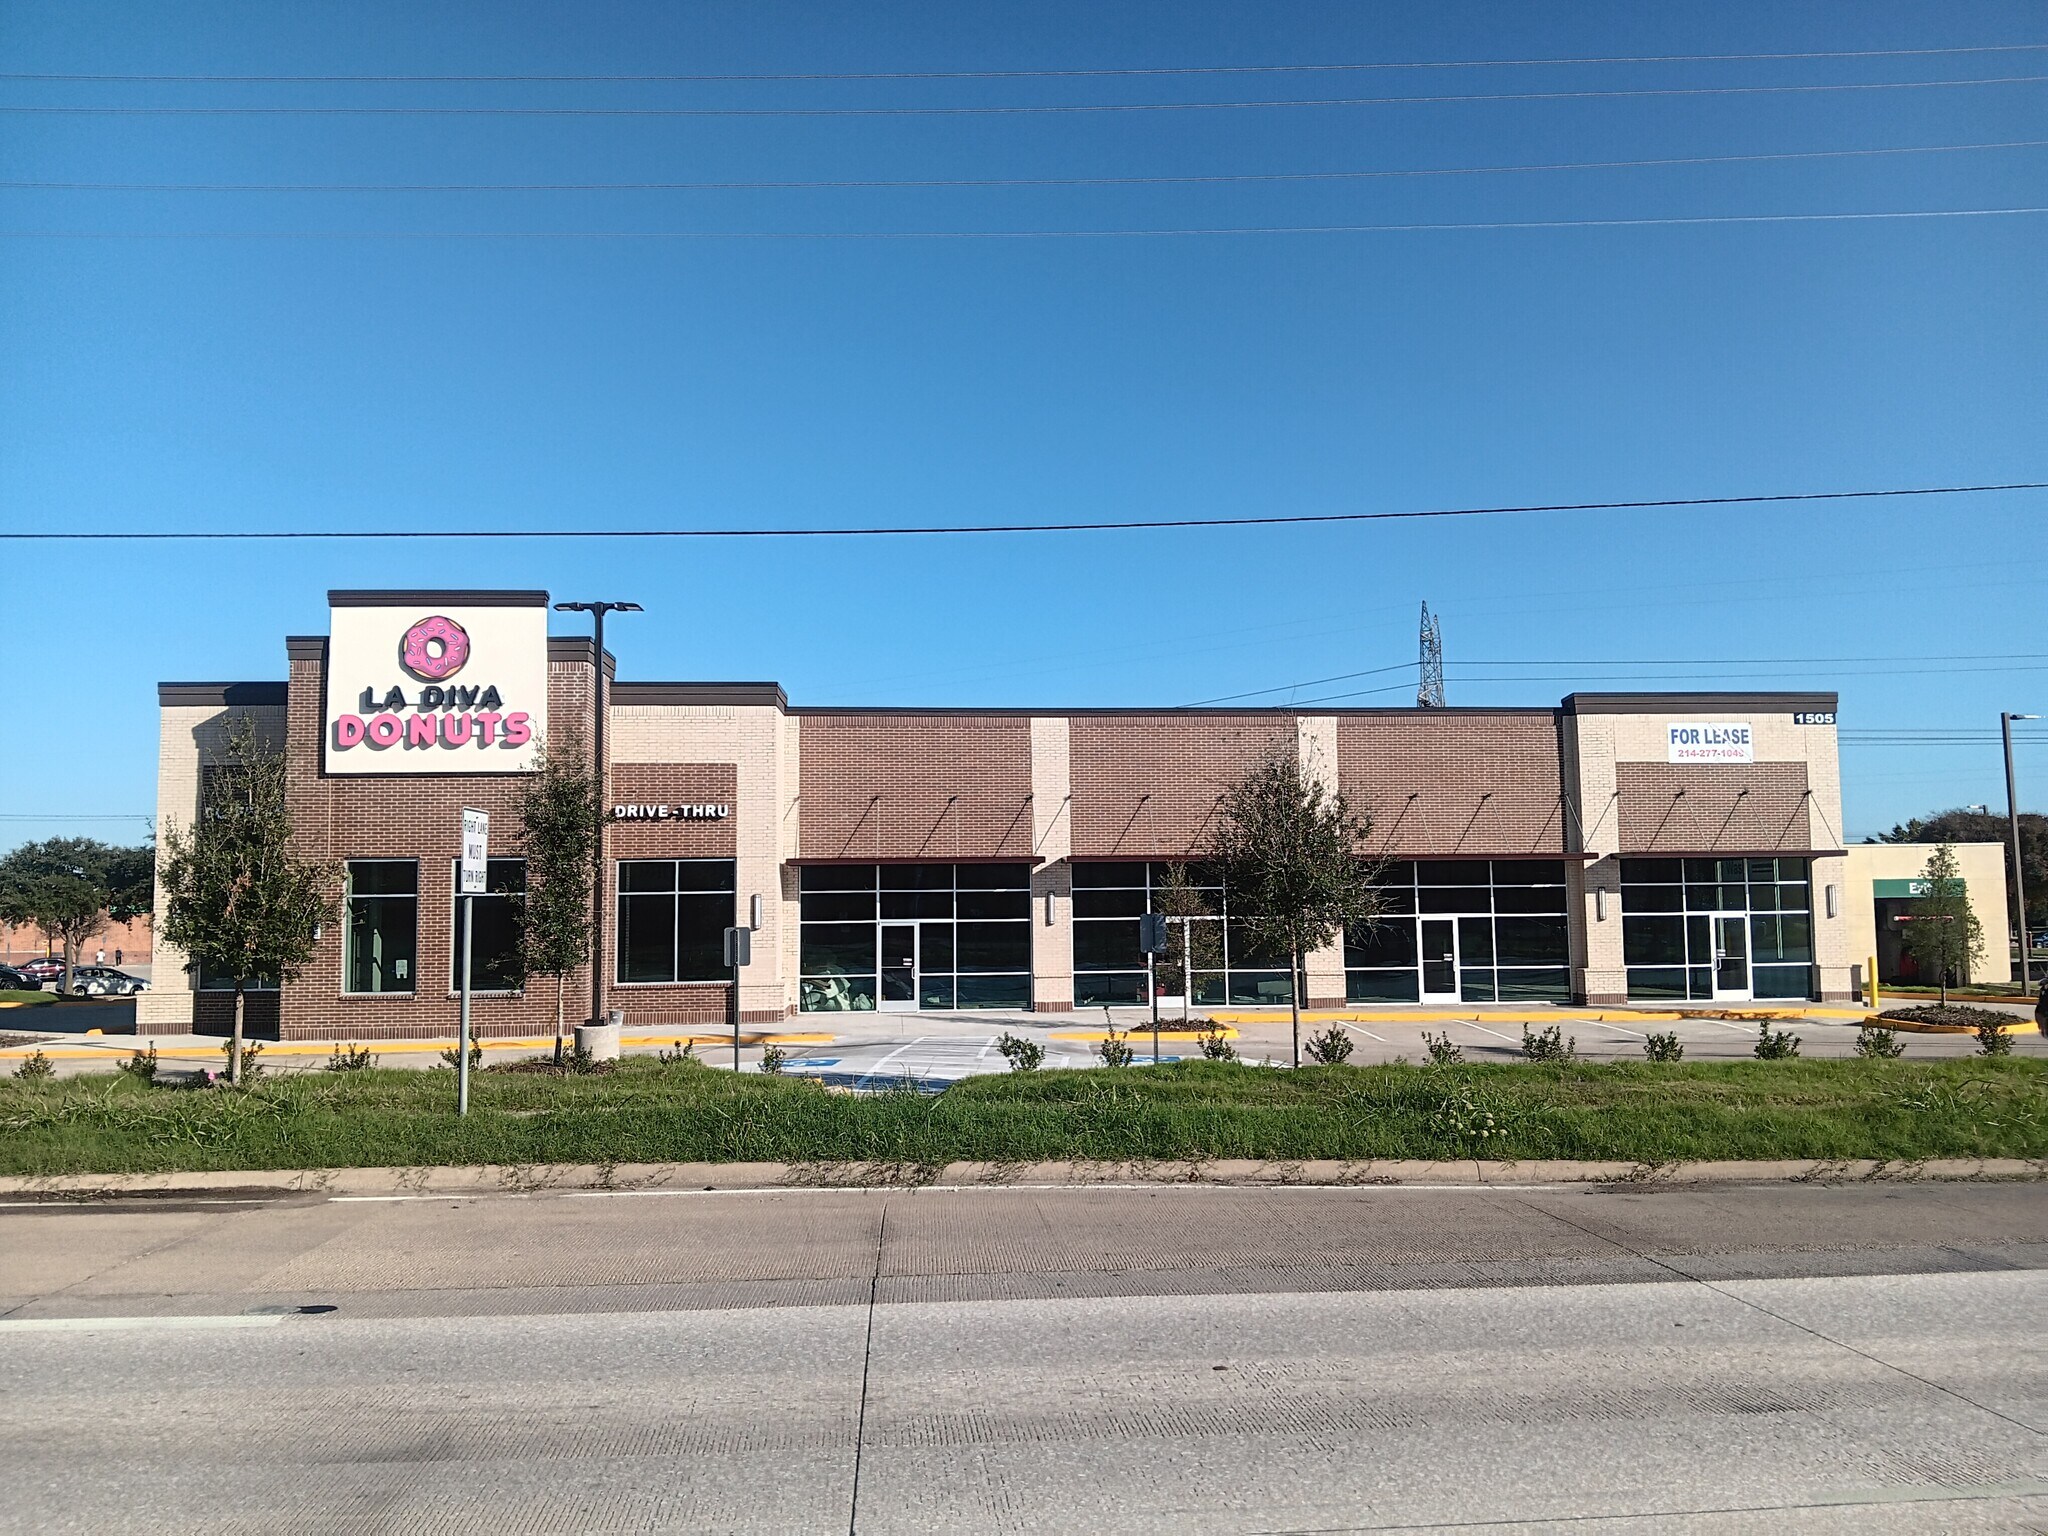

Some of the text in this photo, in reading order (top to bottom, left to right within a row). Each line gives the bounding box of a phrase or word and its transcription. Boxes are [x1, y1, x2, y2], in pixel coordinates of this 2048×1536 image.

[365, 684, 503, 709] LA DIVA
[1795, 713, 1835, 724] 1505
[338, 711, 531, 746] DONUTS
[1670, 728, 1750, 745] FOR LEASE
[614, 804, 729, 818] DRIVE-THRU
[464, 819, 476, 833] RIGHT
[468, 843, 482, 860] MUST
[463, 869, 487, 883] TURN RIGHT
